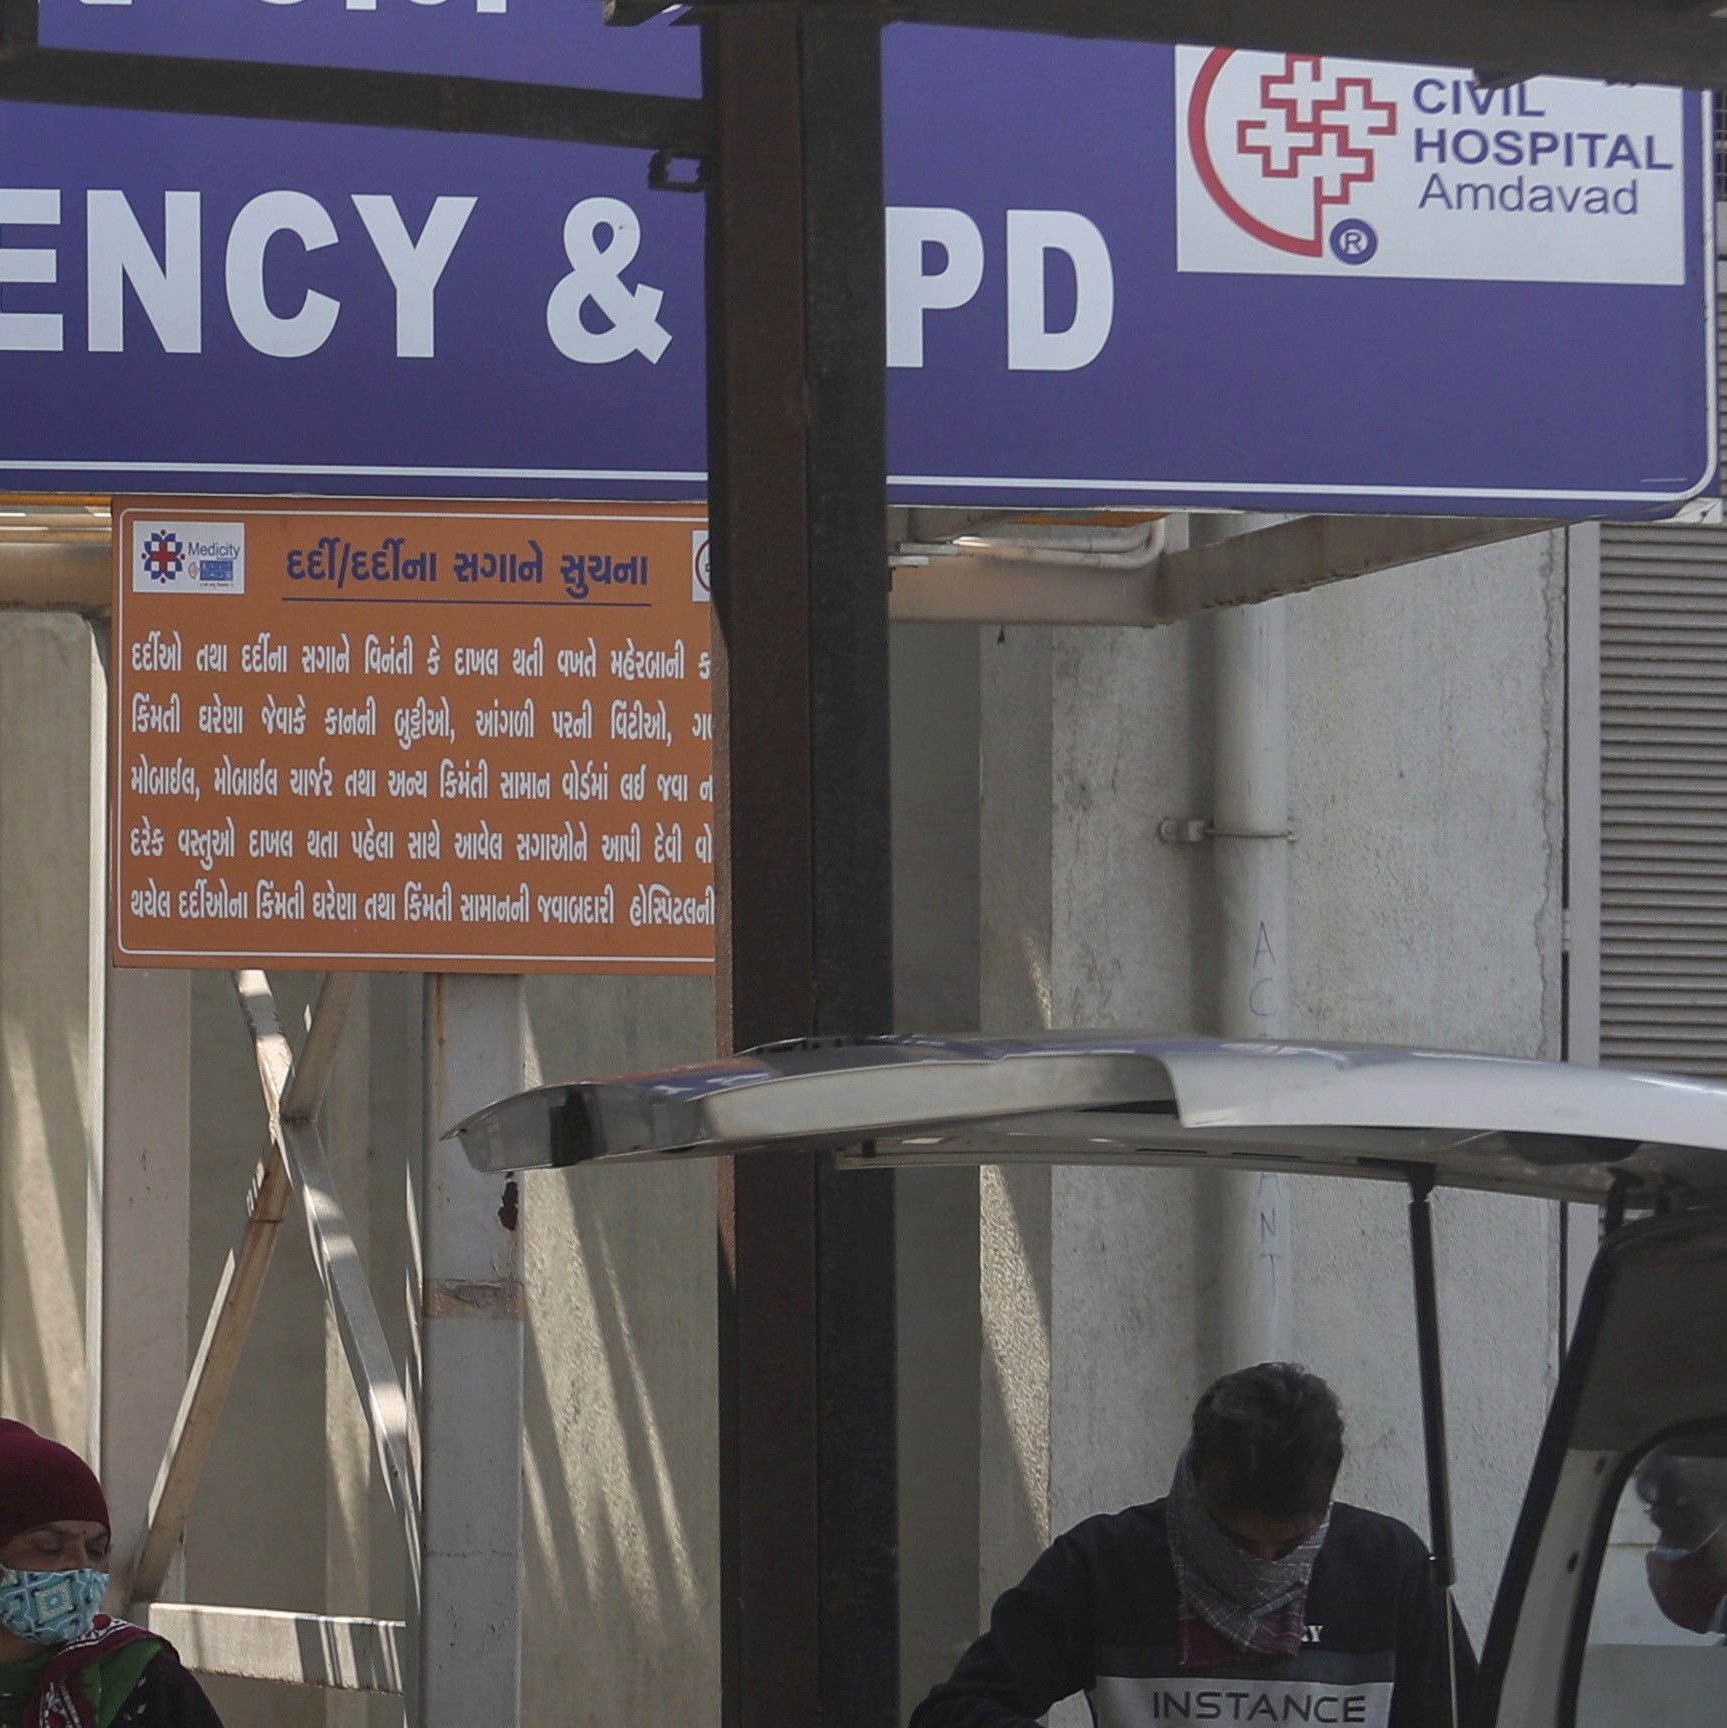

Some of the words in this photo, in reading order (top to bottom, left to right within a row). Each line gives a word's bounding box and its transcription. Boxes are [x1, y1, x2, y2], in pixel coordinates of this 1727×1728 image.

[1413, 78, 1546, 118] CIVIL
[1414, 127, 1675, 171] HOSPITAL
[1418, 172, 1638, 215] Amdavad
[545, 197, 673, 365] &
[885, 206, 1115, 371] PD
[187, 541, 241, 560] Medicity
[288, 537, 437, 586] દર્દી/દર્દીના
[454, 540, 543, 582] સગાને
[131, 630, 182, 672] દર્દીઓ
[196, 643, 228, 672] તથા
[241, 632, 288, 673] દર્દીના
[301, 632, 350, 674] સગાને
[364, 633, 414, 675] વિનંતી
[426, 634, 441, 676] કે
[454, 647, 499, 677] દાખલ
[556, 636, 597, 678] વખતે
[610, 637, 685, 681] મહેરબાની
[132, 692, 181, 733] કિંમતી
[324, 695, 377, 736] કાનની
[475, 697, 535, 738] આંગળી
[551, 698, 593, 739] પરની
[131, 753, 200, 802] મોબાઈલ,
[213, 754, 278, 797] મોબાઈલ
[344, 768, 376, 798] તથા
[387, 769, 428, 798] અન્ય
[499, 771, 551, 800] સામાન
[561, 759, 609, 801] વોર્ડમાં
[620, 763, 647, 801] લઈ
[656, 773, 689, 802] જવા
[130, 815, 165, 857] દરેક
[177, 816, 235, 871] વસ્તુઓ
[249, 829, 293, 858] દાખલ
[306, 829, 338, 859] થતા
[350, 817, 394, 862] પહેલા
[407, 818, 441, 860] સાથે
[454, 819, 503, 861] આવેલ
[515, 820, 588, 862] સગાઓને
[601, 822, 641, 863] આપી
[654, 822, 682, 864] દેવી
[130, 877, 171, 919] થયેલ
[178, 878, 248, 919] દર્દીઓના
[256, 879, 305, 920] કિંમતી
[364, 891, 396, 921] તથા
[404, 880, 453, 922] કિંમતી
[459, 882, 530, 923] સામાનની
[537, 883, 615, 924] જવાબદારી
[629, 883, 716, 927] હોસ્પિટલની
[1153, 1690, 1367, 1724] INSTANCE
